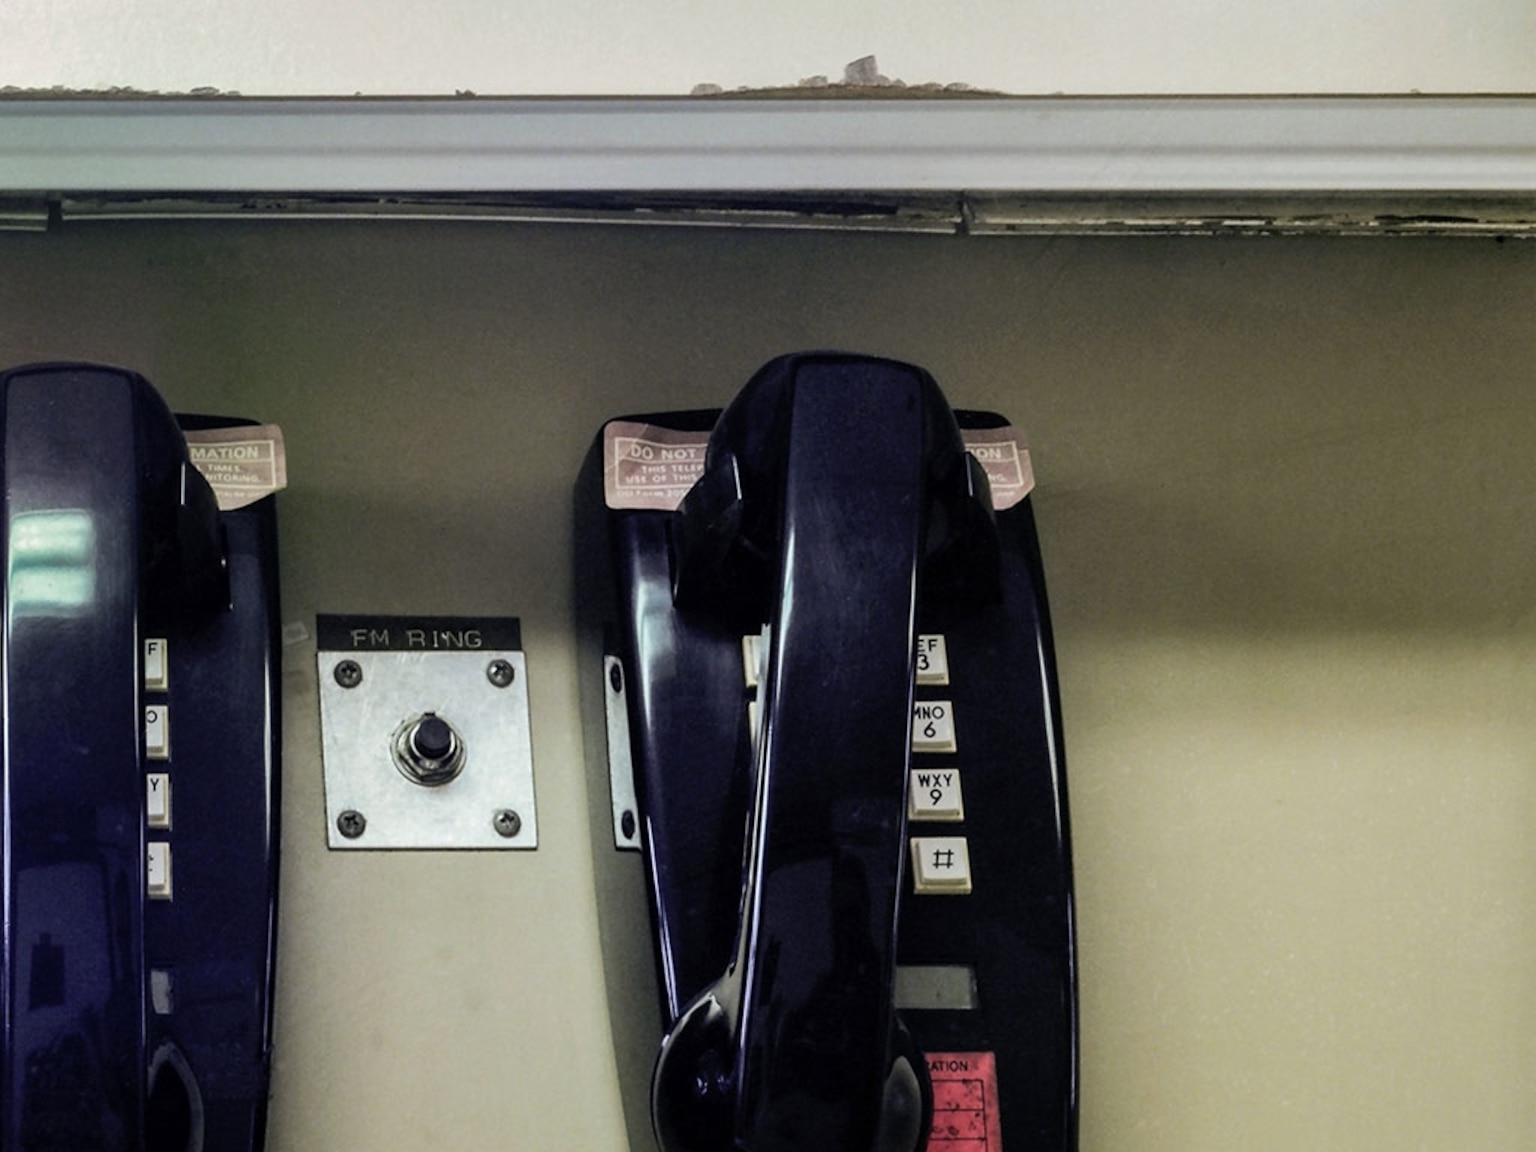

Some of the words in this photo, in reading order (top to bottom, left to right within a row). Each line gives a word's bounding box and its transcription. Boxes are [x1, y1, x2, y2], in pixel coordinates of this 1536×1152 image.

[190, 446, 259, 459] MATION
[630, 444, 654, 460] DO
[661, 448, 697, 460] NOT
[350, 629, 390, 647] FM
[406, 629, 483, 648] RING
[917, 639, 939, 652] EF
[918, 653, 930, 671] 3
[923, 721, 937, 738] 6
[917, 774, 953, 788] WXY
[929, 788, 943, 806] 9
[928, 1060, 969, 1072] ATION
